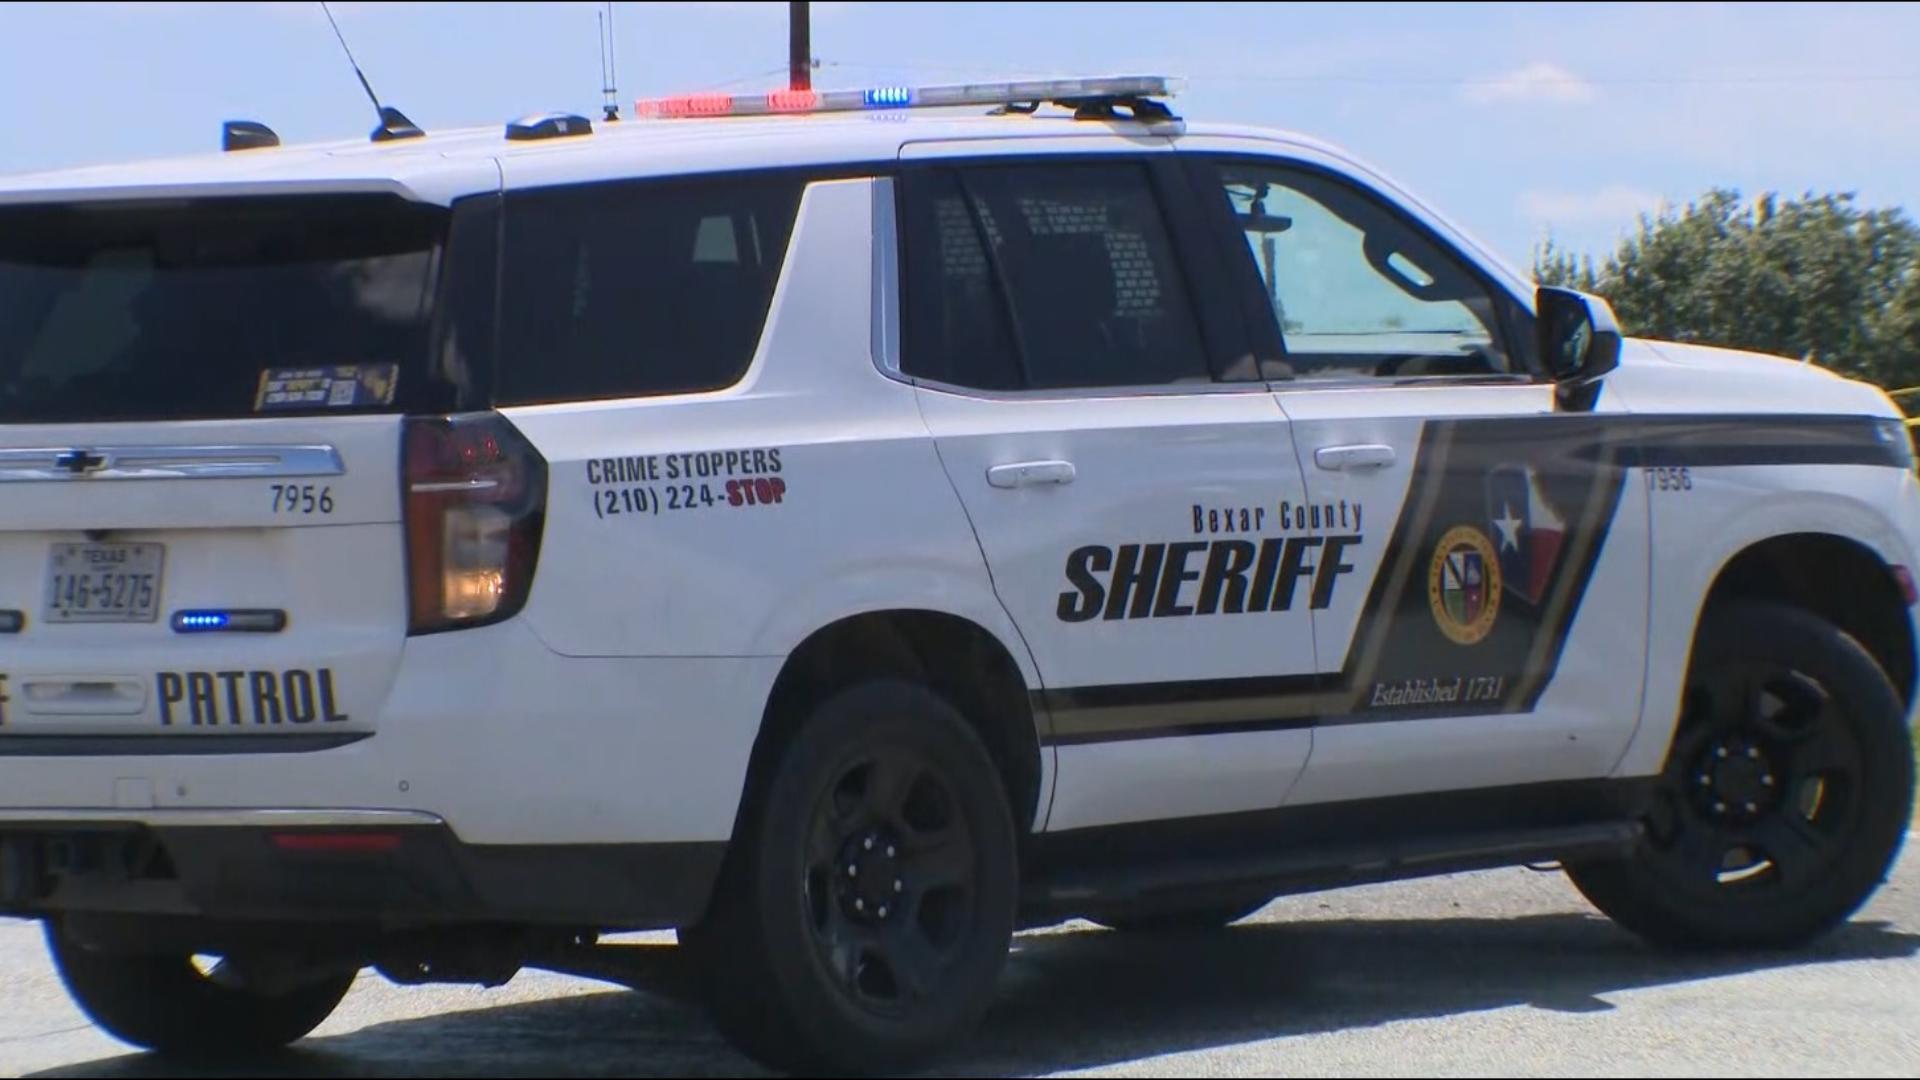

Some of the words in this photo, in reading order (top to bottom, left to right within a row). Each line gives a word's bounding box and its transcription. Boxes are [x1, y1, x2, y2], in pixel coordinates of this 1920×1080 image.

[587, 456, 659, 484] CRIME
[666, 448, 782, 479] STOPPERS
[271, 485, 334, 514] 7956
[594, 487, 658, 519] (210)
[666, 476, 786, 510] 224-STOP
[1192, 502, 1264, 534] Bexar
[1280, 500, 1362, 531] County
[82, 549, 126, 563] TEXAS
[1056, 534, 1363, 622] SHERIFF
[156, 667, 349, 726] PATROL
[1370, 678, 1461, 707] Established
[1464, 676, 1503, 700] 1731
